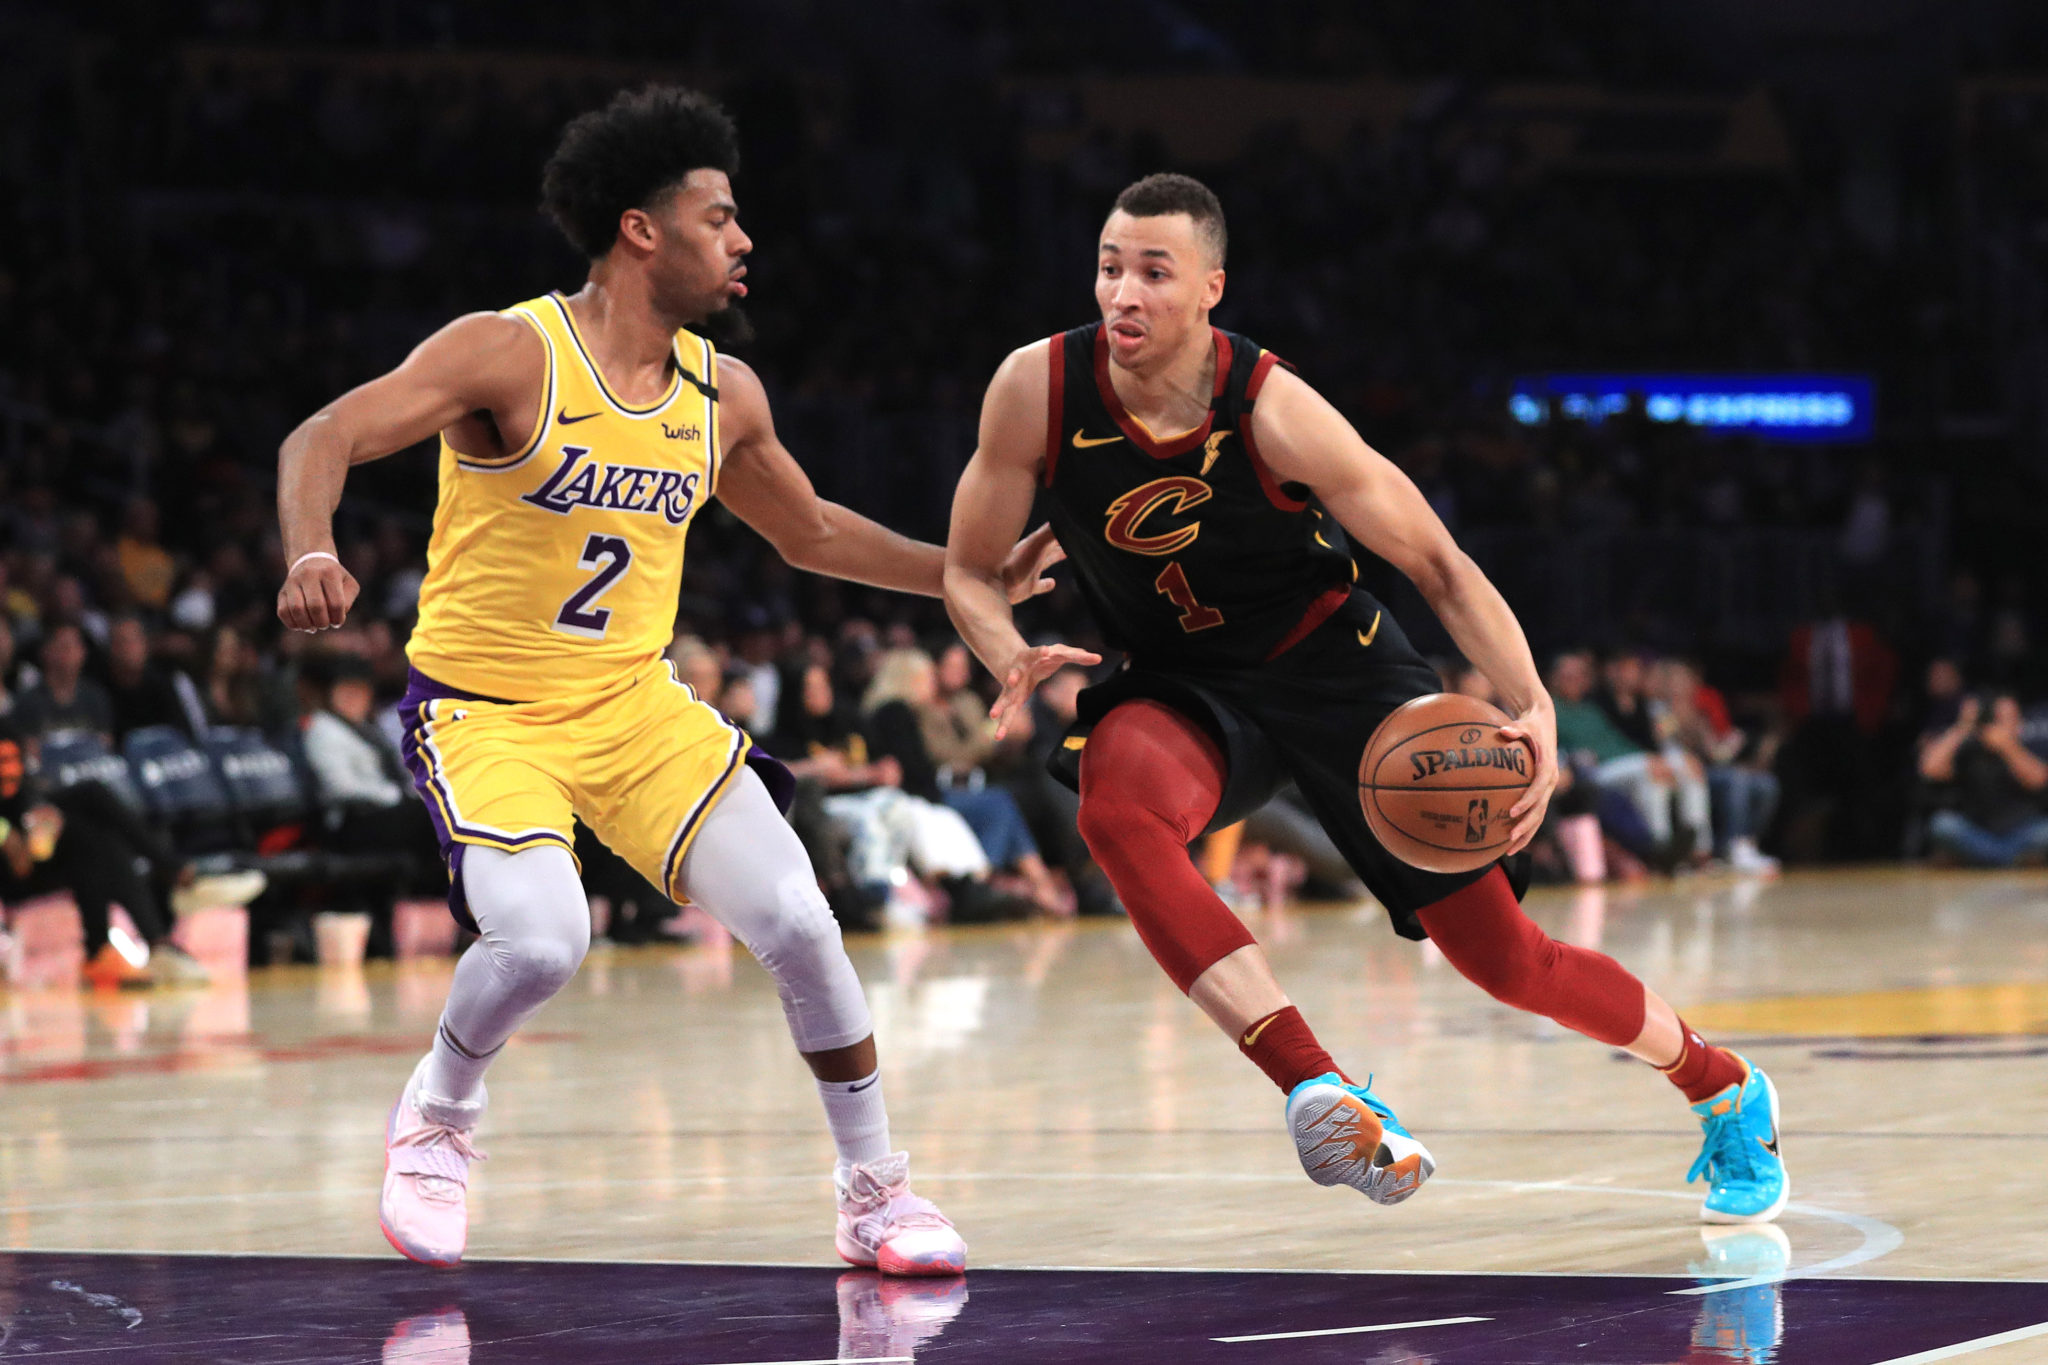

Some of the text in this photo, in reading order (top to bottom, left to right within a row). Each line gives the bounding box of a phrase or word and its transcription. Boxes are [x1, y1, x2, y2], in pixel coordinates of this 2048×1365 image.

[662, 423, 700, 441] wish
[520, 446, 699, 524] LAKERS
[1105, 476, 1212, 555] C
[552, 532, 633, 639] 2
[1155, 561, 1224, 632] 1
[1411, 748, 1527, 780] SPALDING
